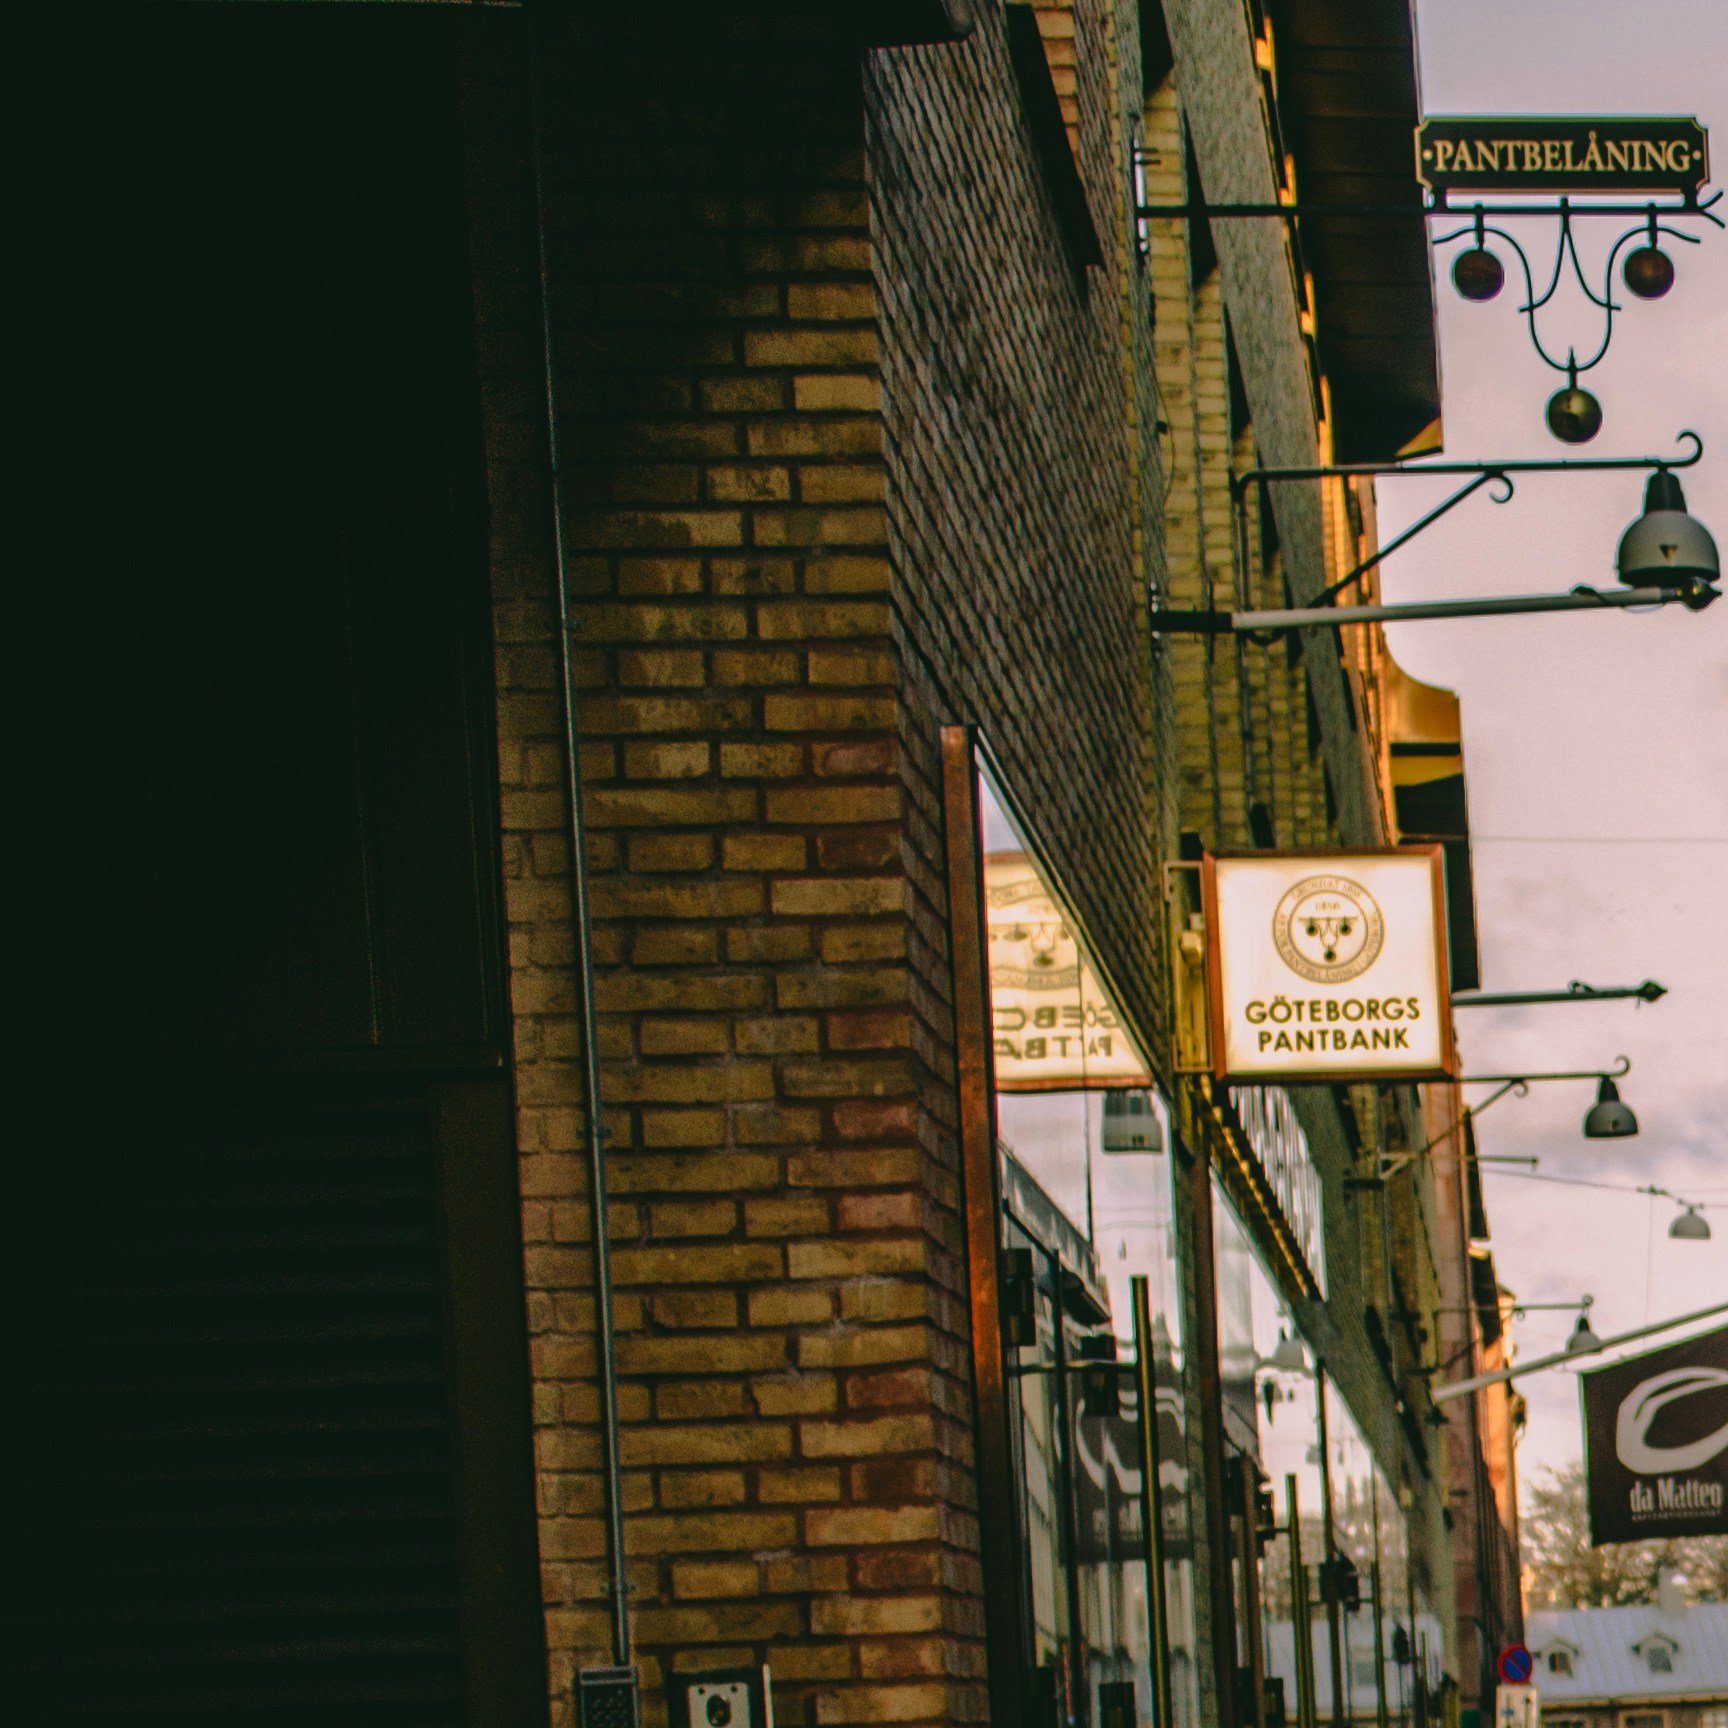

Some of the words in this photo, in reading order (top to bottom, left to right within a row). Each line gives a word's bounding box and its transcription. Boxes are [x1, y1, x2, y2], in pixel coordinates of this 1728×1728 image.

[1433, 130, 1692, 173] PANTBELÅNING
[1245, 995, 1420, 1024] GÖTEBORGS
[1257, 1027, 1409, 1053] PANTBANK
[1629, 1479, 1654, 1513] da
[1656, 1476, 1724, 1511] Matteo
